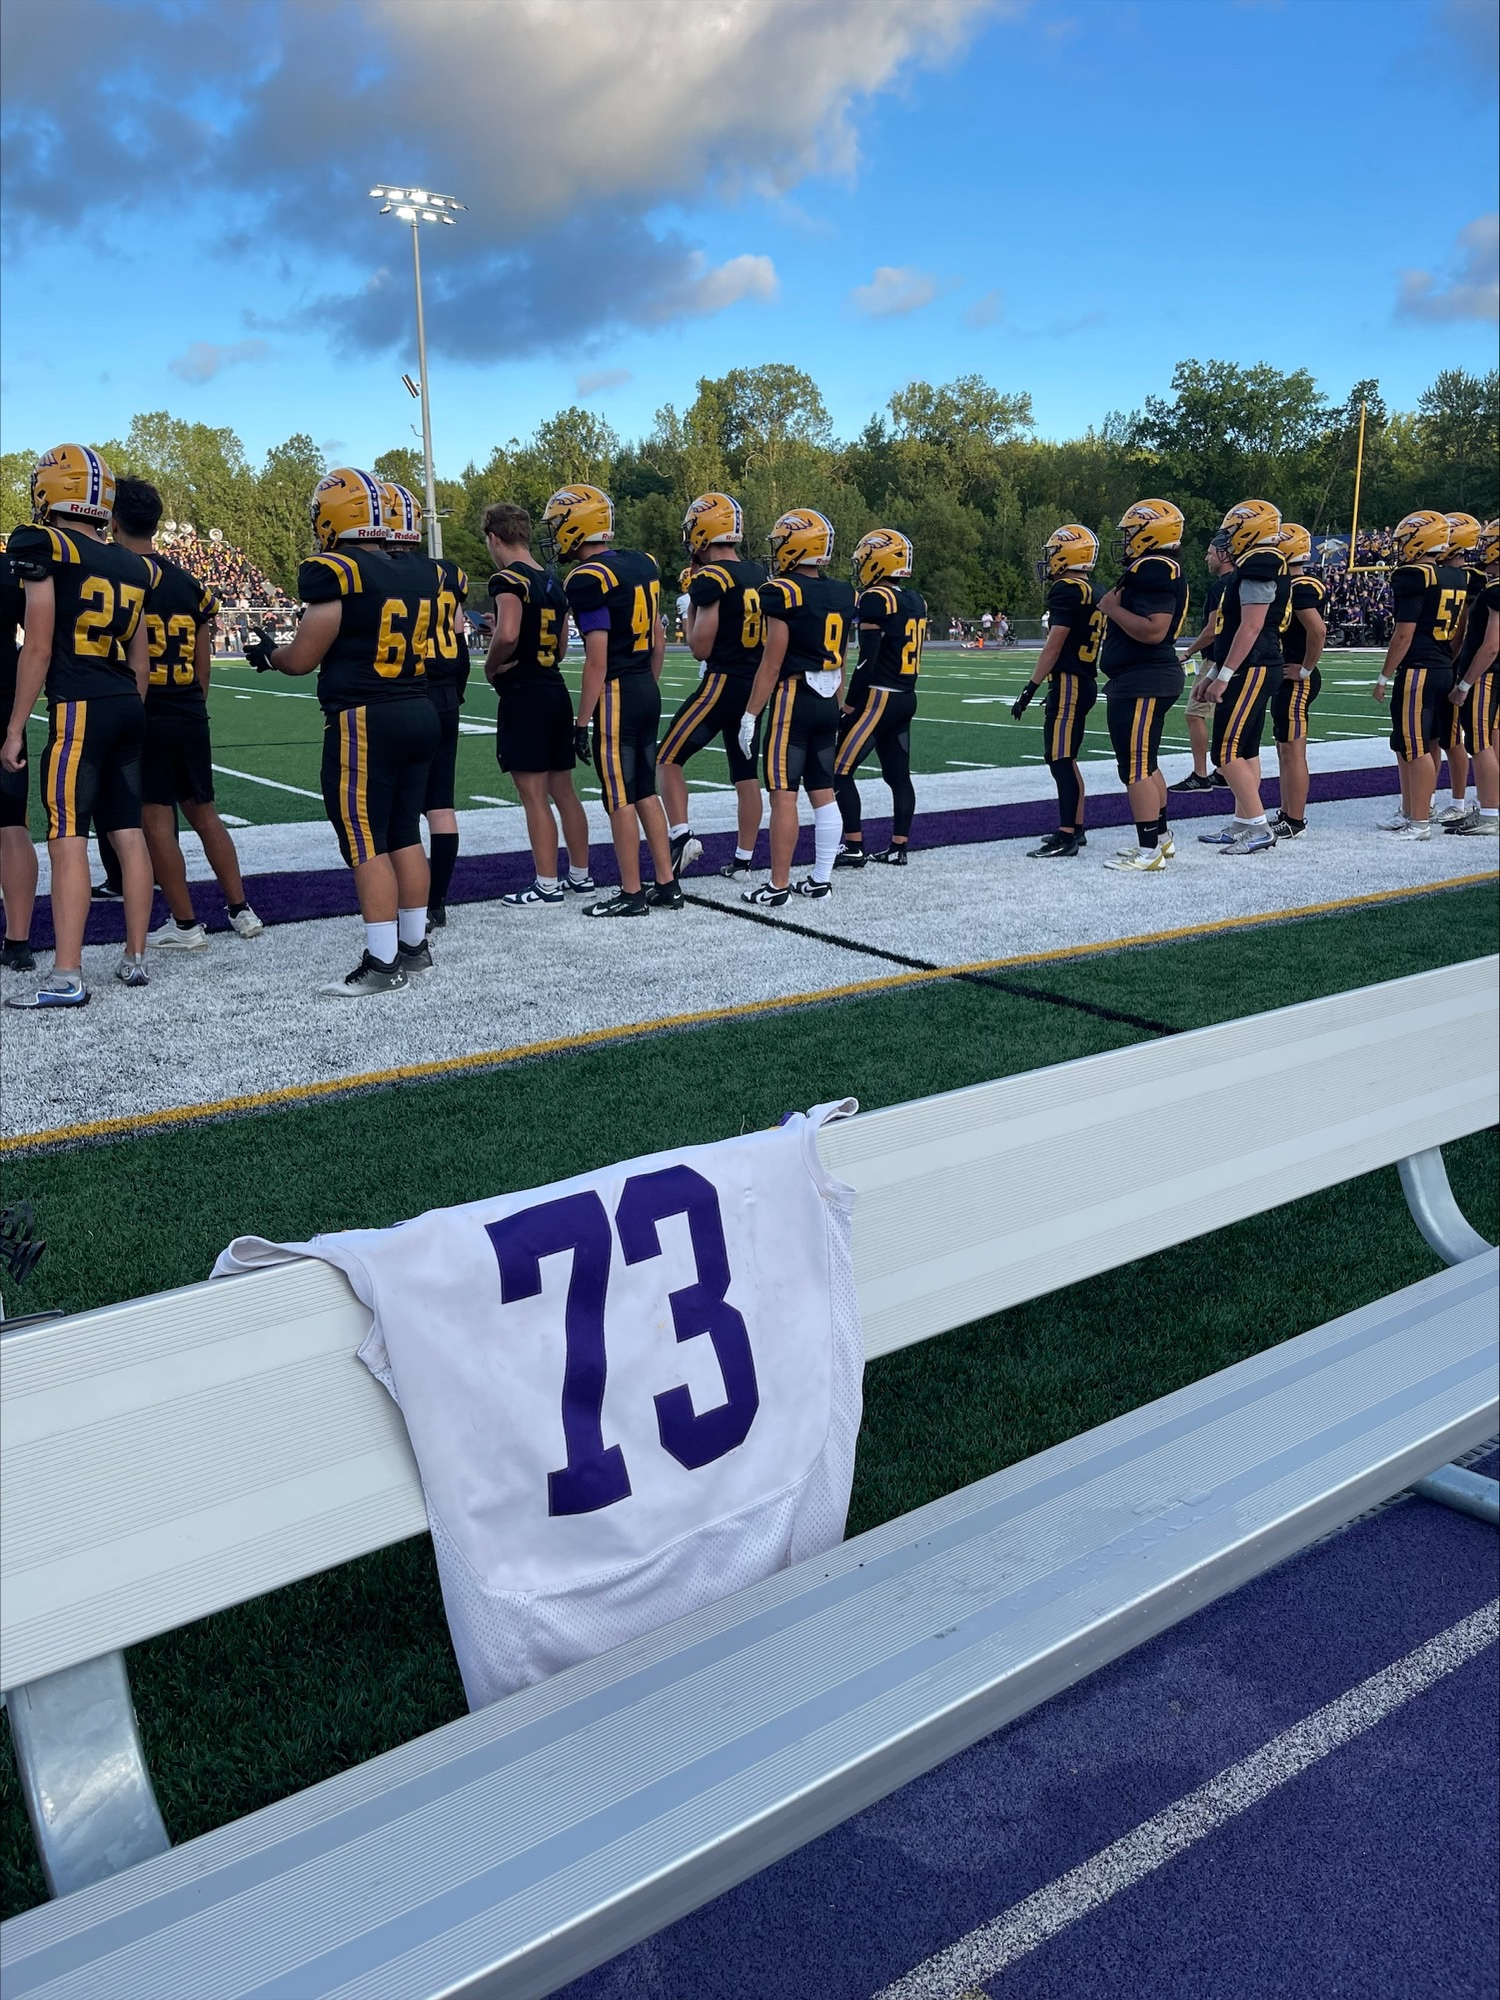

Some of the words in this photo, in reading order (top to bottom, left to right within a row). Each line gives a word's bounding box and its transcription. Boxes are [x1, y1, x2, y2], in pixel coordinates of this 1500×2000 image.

[69, 503, 109, 519] Riddell
[74, 575, 146, 662] 27
[373, 598, 431, 679] 64
[536, 608, 558, 667] 5
[823, 612, 844, 671] 9
[1433, 588, 1468, 641] 57
[144, 613, 197, 686] 23
[900, 617, 928, 675] 20
[483, 1163, 760, 1518] 73
